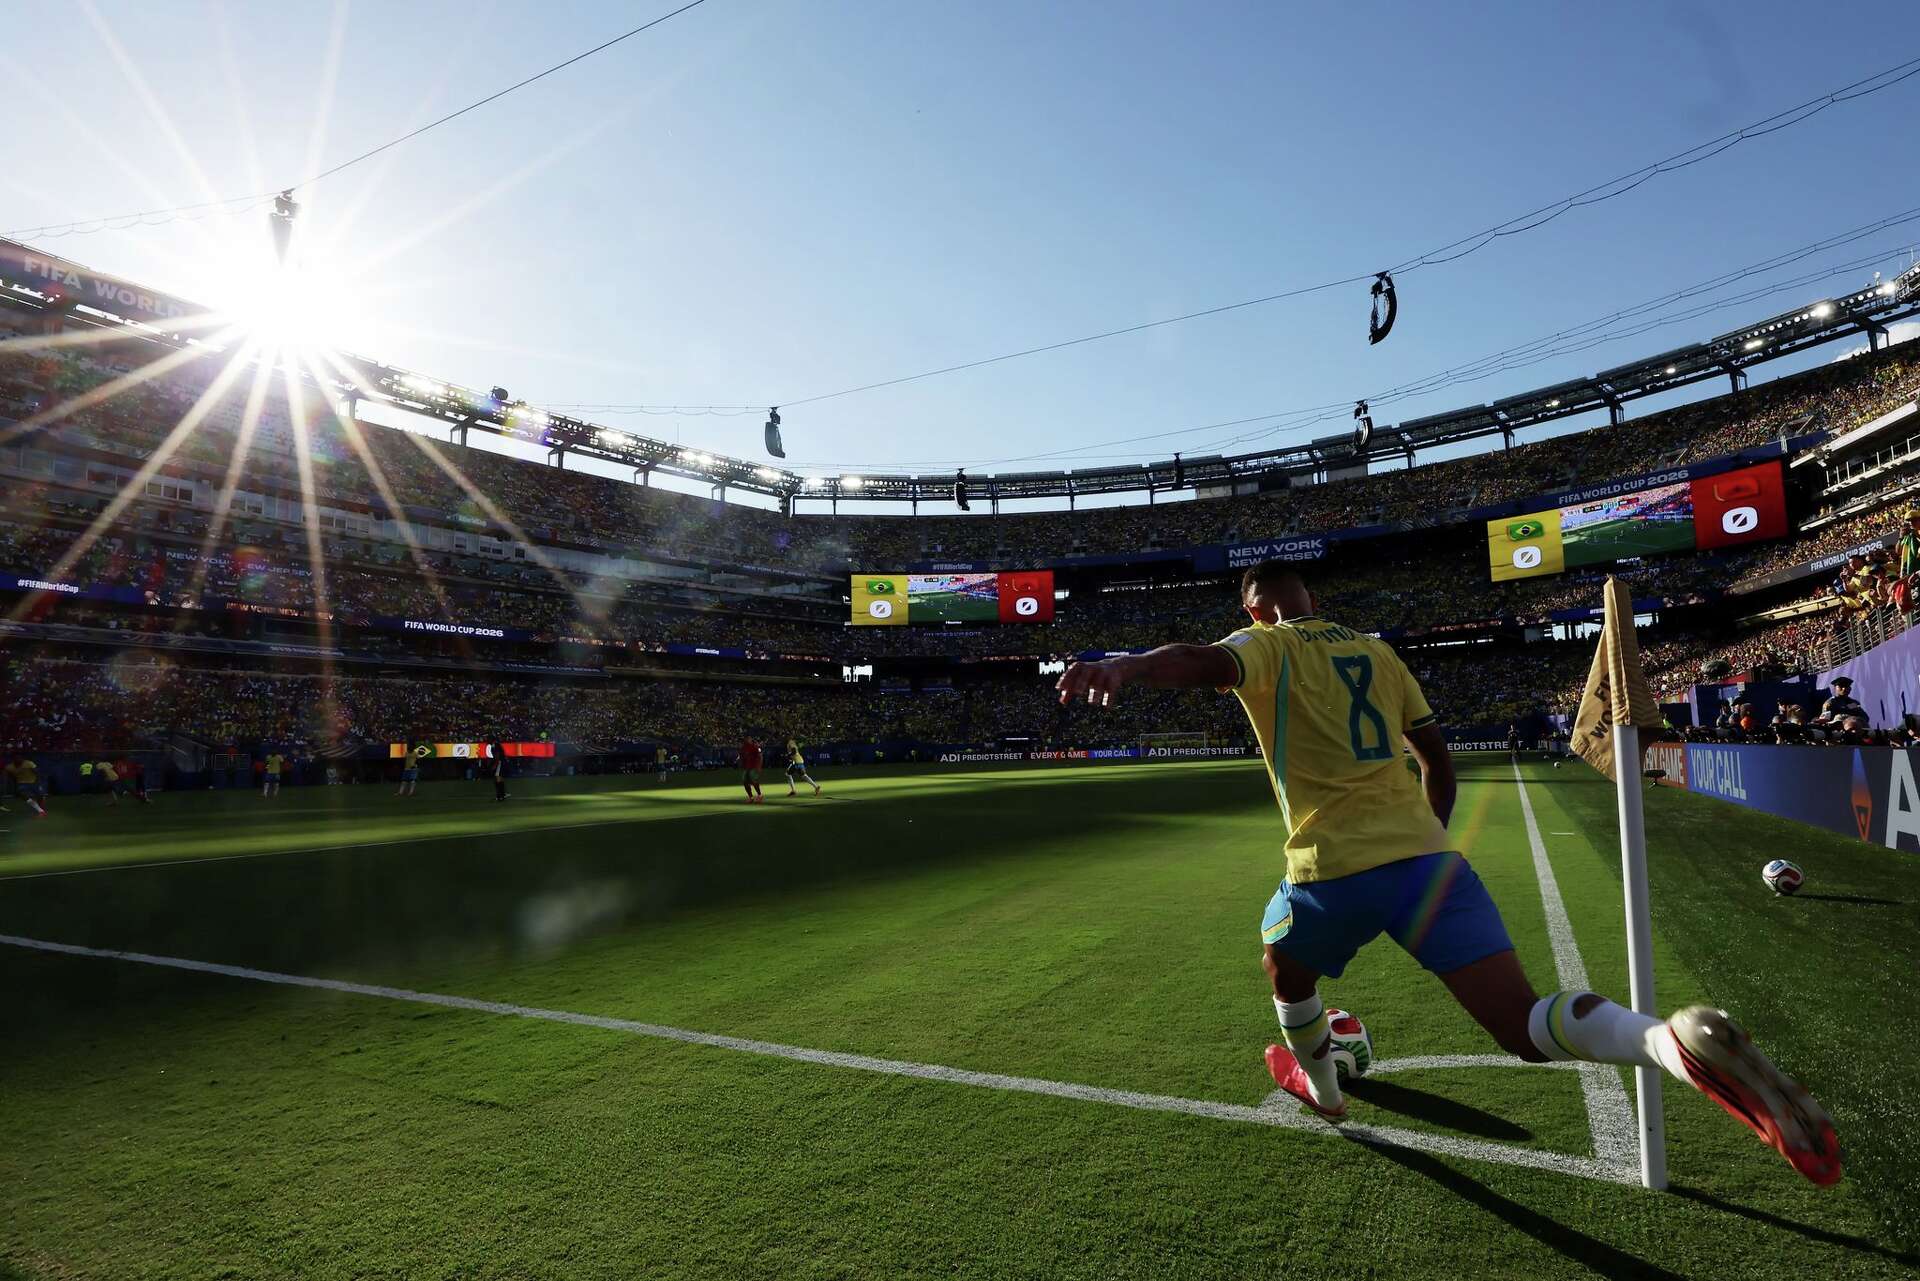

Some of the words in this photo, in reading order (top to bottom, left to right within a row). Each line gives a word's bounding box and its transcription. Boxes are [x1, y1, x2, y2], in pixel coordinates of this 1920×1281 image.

[24, 254, 82, 289] FIFA
[1558, 492, 1580, 505] FIFA
[1582, 484, 1621, 501] WORLD
[1623, 478, 1645, 492] CUP
[1647, 469, 1690, 486] 2026
[1228, 546, 1268, 559] NEW
[1272, 538, 1323, 553] YORK
[1810, 561, 1824, 572] FIFA
[1824, 554, 1846, 567] WORLD
[1858, 540, 1884, 555] 2026
[1229, 557, 1263, 568] NEW
[17, 578, 80, 595] #FIFAWorldCup
[404, 621, 424, 631] FIFA
[425, 623, 456, 634] WORLD
[458, 626, 475, 635] CUP
[475, 628, 504, 638] 2026
[1331, 655, 1394, 761] 8
[940, 753, 960, 763] ADI
[962, 752, 1024, 762] PREDICTSTREET
[1030, 751, 1059, 761] EVERY
[1060, 751, 1087, 760] GAME
[1093, 750, 1112, 759] YOUR
[1113, 750, 1132, 758] CALL
[1148, 748, 1170, 757] ADI
[1173, 746, 1246, 756] PREDICTSTREET
[1690, 749, 1715, 792] YOUR
[1716, 750, 1747, 801] CALL
